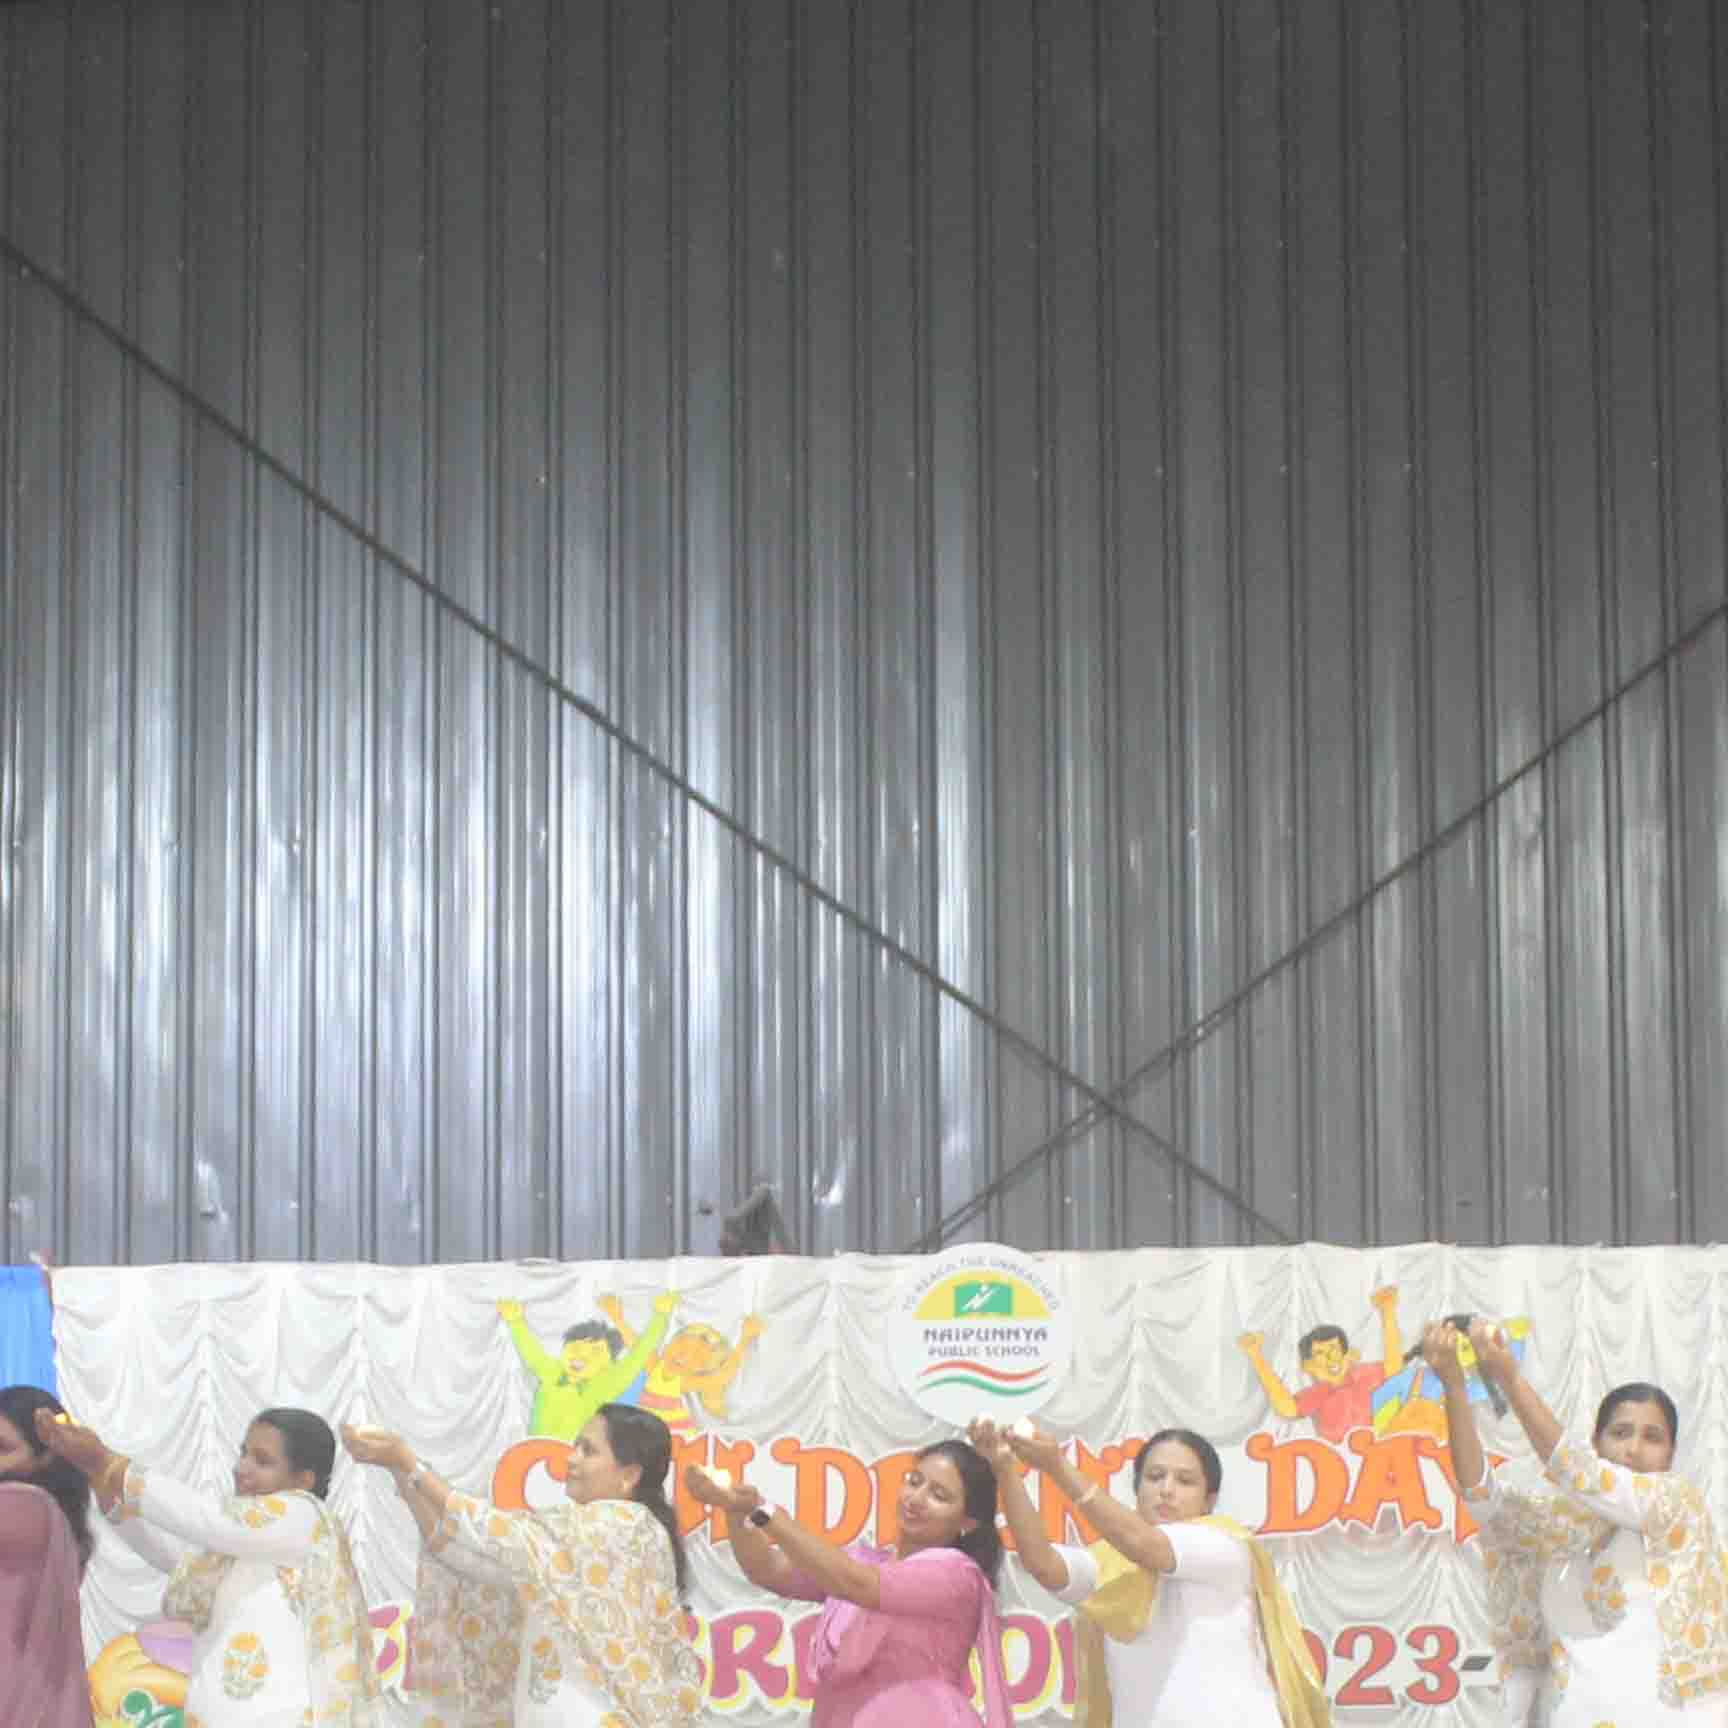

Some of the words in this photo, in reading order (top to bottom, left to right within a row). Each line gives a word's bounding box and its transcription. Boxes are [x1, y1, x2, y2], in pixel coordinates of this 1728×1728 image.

[923, 1327, 1048, 1343] NAIPUNNYA
[927, 1344, 979, 1358] PUBLIC
[984, 1344, 1041, 1358] SCHOOL
